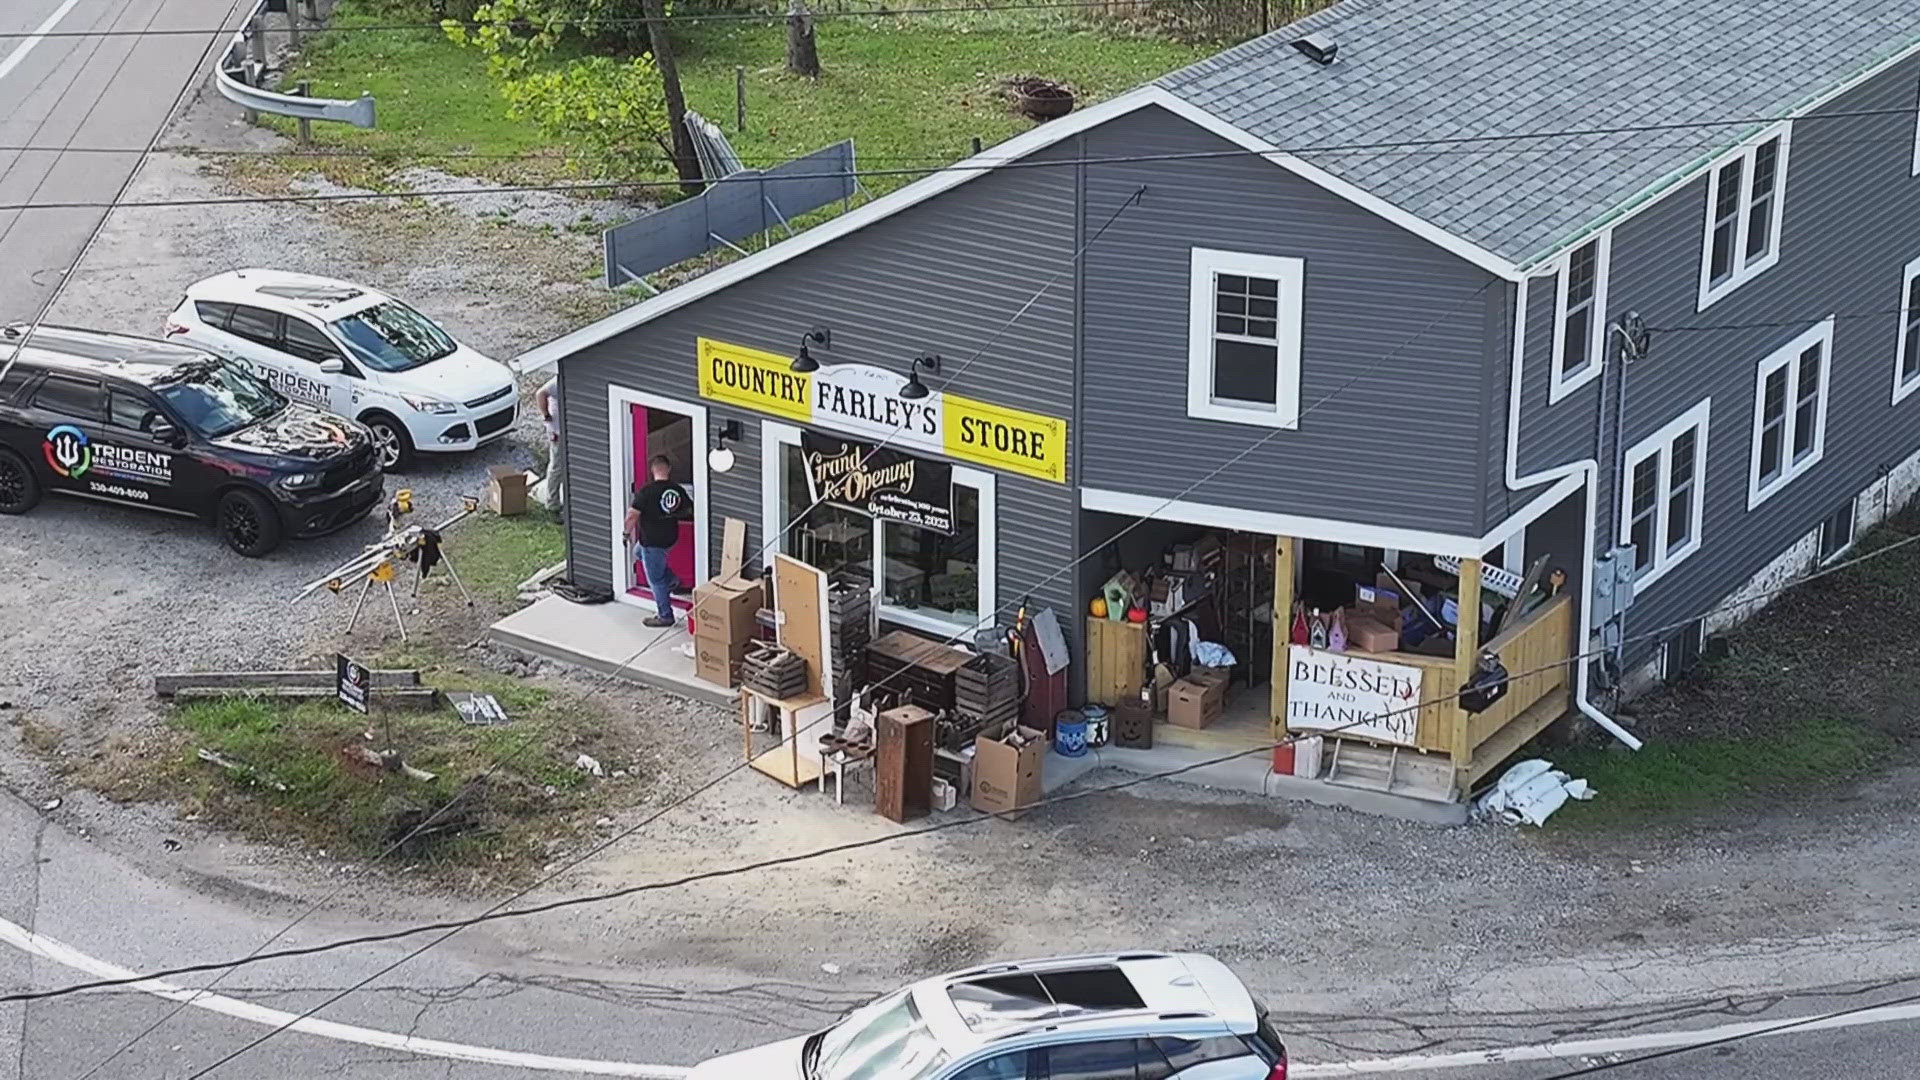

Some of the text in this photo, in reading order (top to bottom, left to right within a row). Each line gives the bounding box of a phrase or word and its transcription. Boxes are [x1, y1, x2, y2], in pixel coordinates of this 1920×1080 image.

[257, 364, 332, 397] TRIDENT
[271, 380, 332, 407] STORATION
[712, 357, 1045, 460] COUNTRY FARLEY'S STORE
[91, 442, 172, 468] TRIDENT
[92, 456, 172, 477] RESTORATION
[809, 443, 868, 484] Grand
[868, 501, 908, 520] October
[1295, 661, 1413, 700] BLESSED
[1327, 691, 1356, 703] AND
